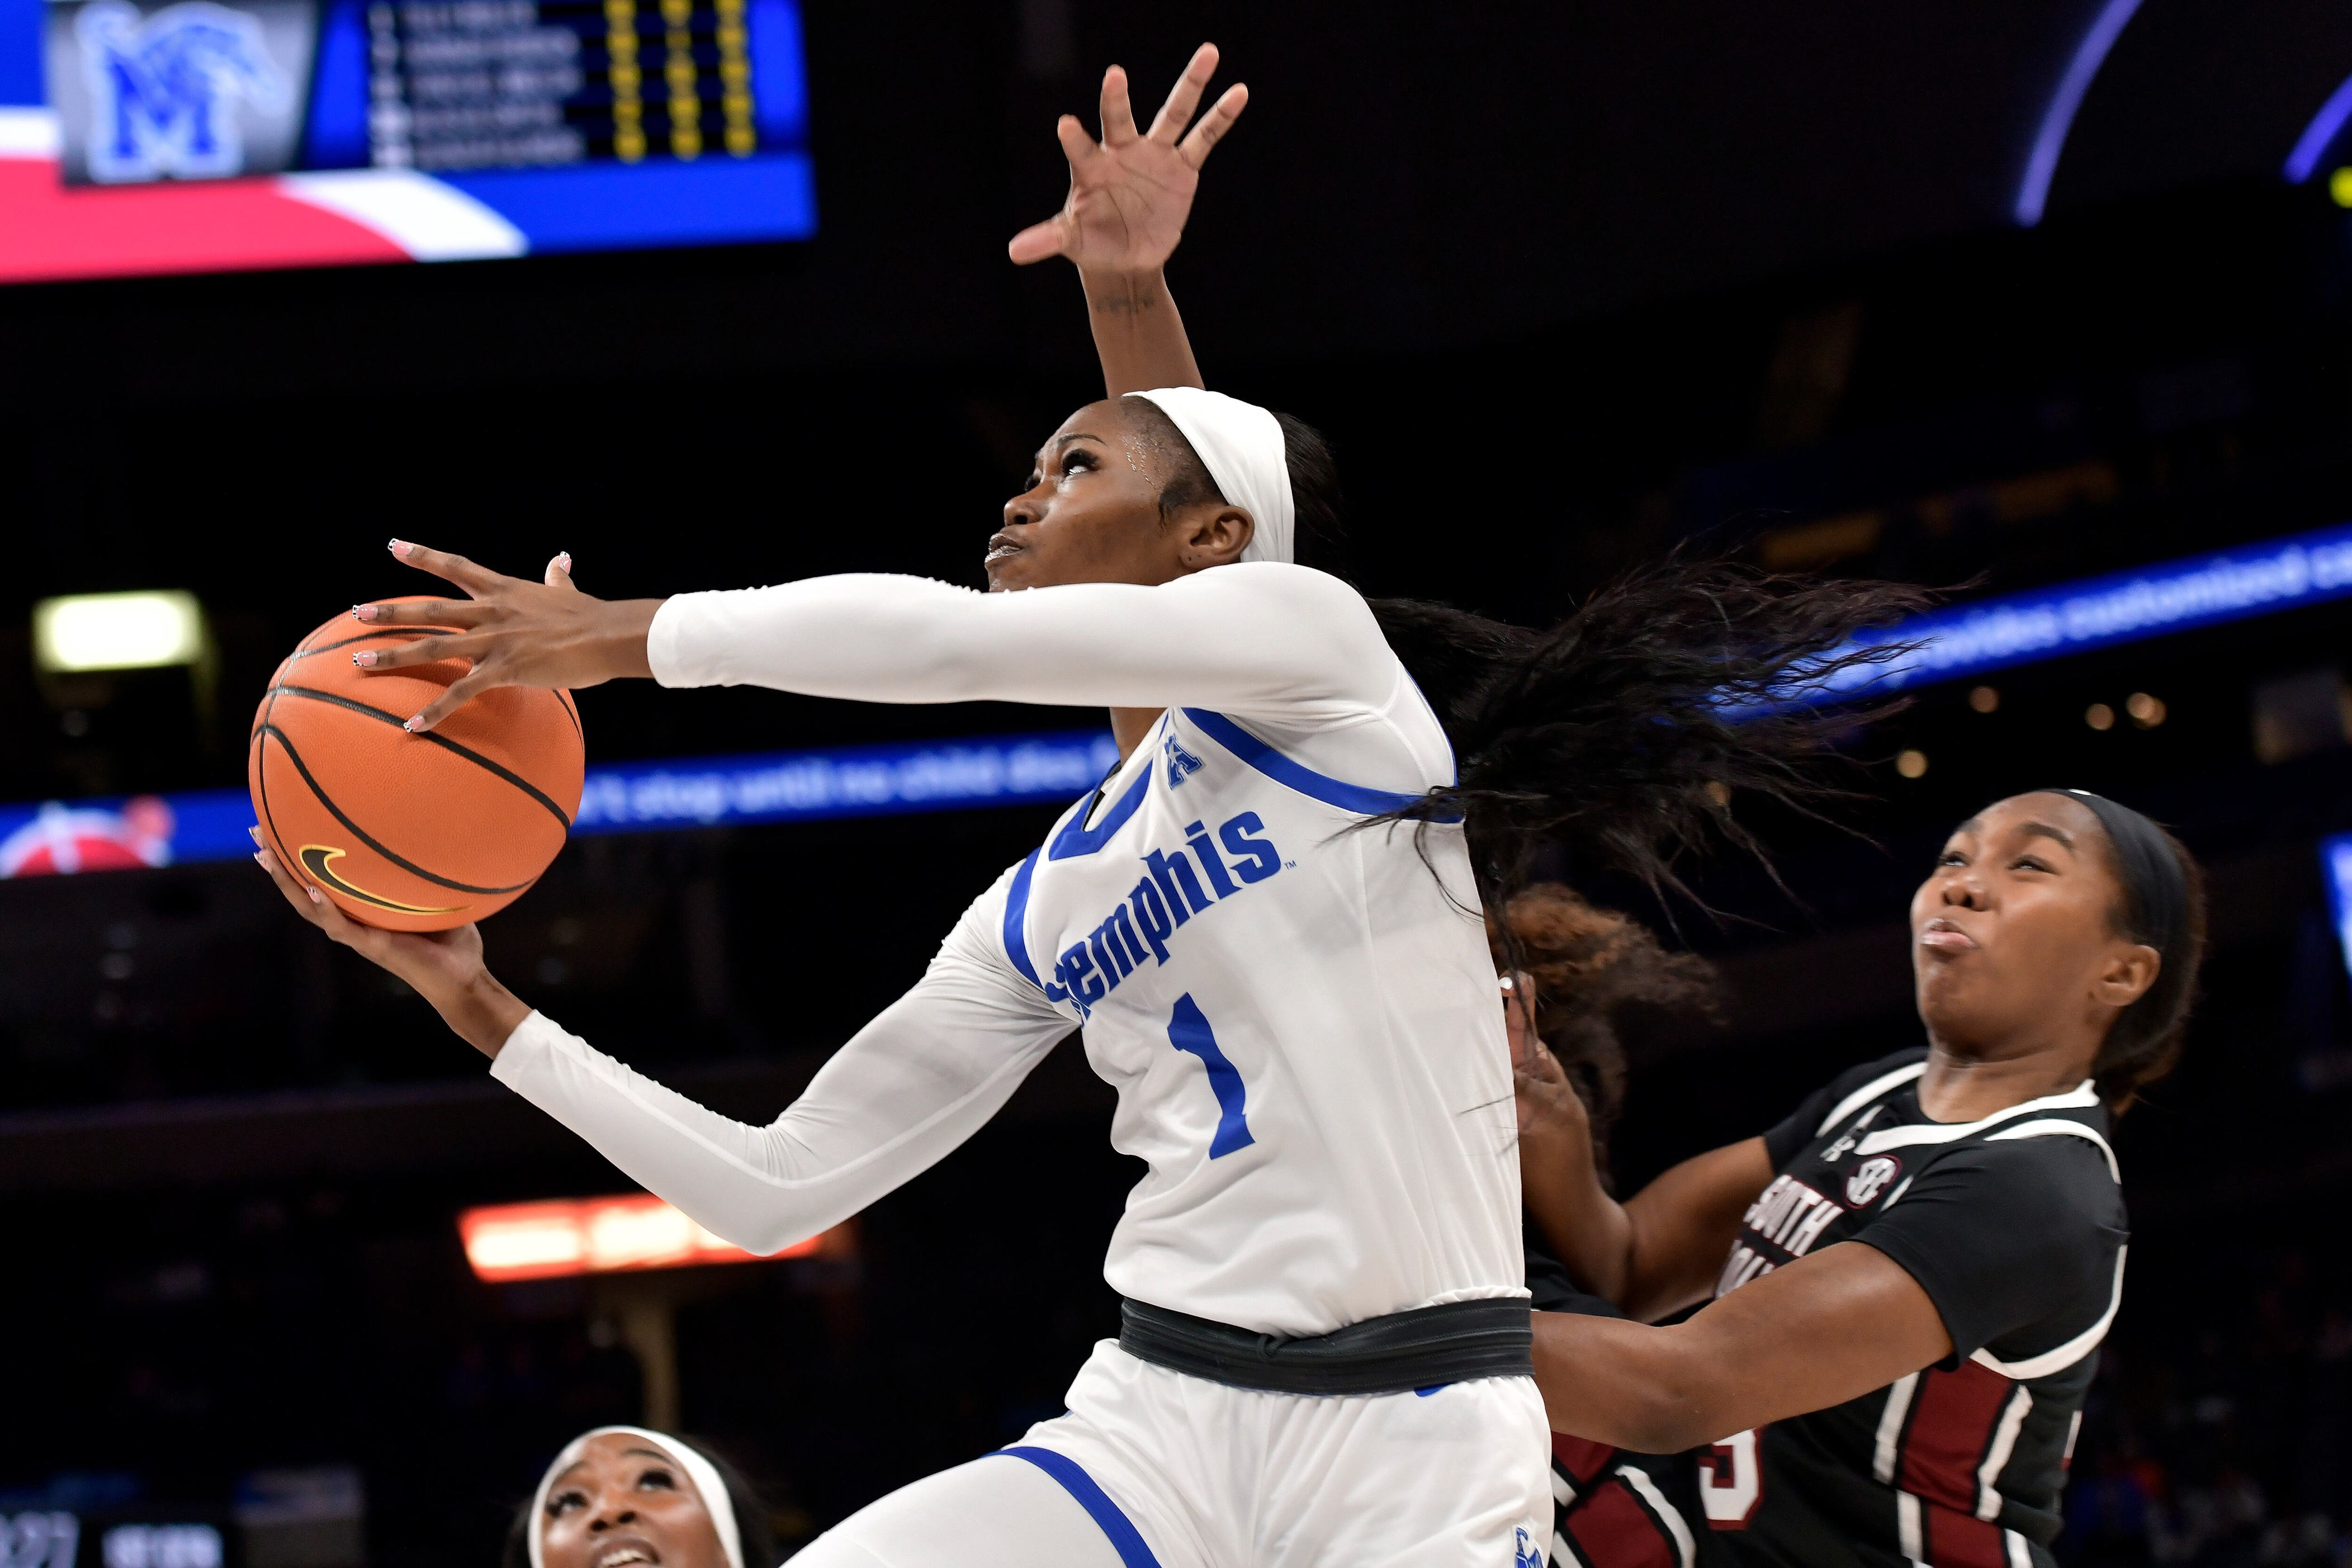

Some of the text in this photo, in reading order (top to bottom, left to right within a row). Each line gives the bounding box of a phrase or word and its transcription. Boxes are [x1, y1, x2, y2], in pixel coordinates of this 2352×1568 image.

[2064, 545, 2307, 638] customized
[633, 770, 723, 824] stop
[736, 757, 829, 813] until
[840, 763, 892, 804] no
[899, 746, 1001, 800] child
[1008, 741, 1086, 793] dies
[1167, 992, 1256, 1160] 1
